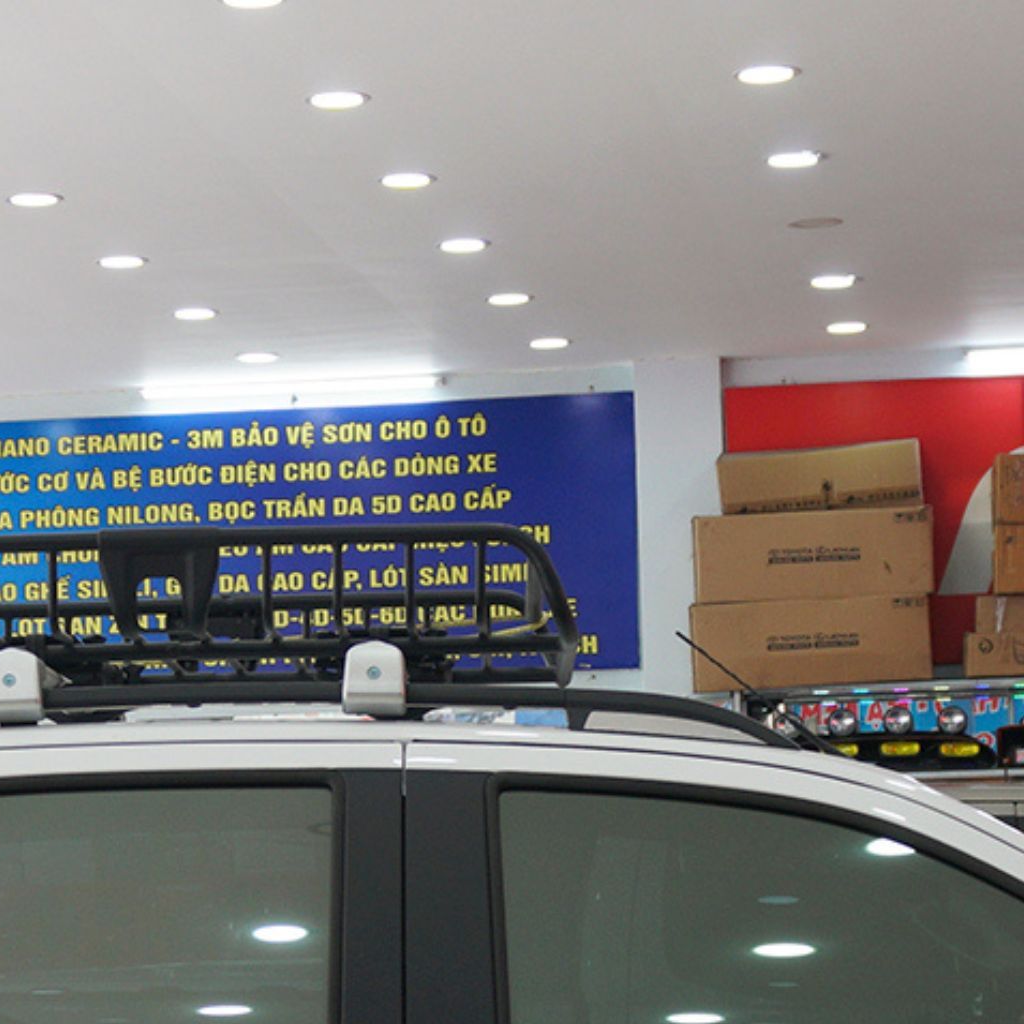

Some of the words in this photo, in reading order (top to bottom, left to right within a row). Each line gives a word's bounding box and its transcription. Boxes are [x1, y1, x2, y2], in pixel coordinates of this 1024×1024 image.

[57, 433, 162, 455] CERAMIC
[188, 430, 223, 448] 3M
[231, 422, 278, 447] BẢO
[286, 422, 314, 448] VỆ
[323, 422, 372, 443] SƠN
[380, 420, 427, 441] CHO
[435, 416, 450, 438] Ô
[458, 413, 486, 436] TÔ
[38, 472, 68, 491] CƠ
[76, 468, 105, 490] VÀ
[113, 466, 141, 491] BỆ
[150, 463, 212, 487] BƯỚC
[220, 461, 276, 487] ĐIỆN
[284, 461, 331, 481] CHO
[339, 457, 386, 480] CÁC
[395, 453, 459, 476] DÒNG
[468, 454, 496, 472] XE
[21, 505, 99, 528] PHÔNG
[107, 503, 200, 524] NILONG,
[208, 501, 255, 523] BỌC
[333, 497, 364, 516] DA
[372, 495, 402, 514] 5D
[410, 492, 456, 512] CAO
[464, 484, 511, 510] CẤP
[219, 574, 250, 594] DA
